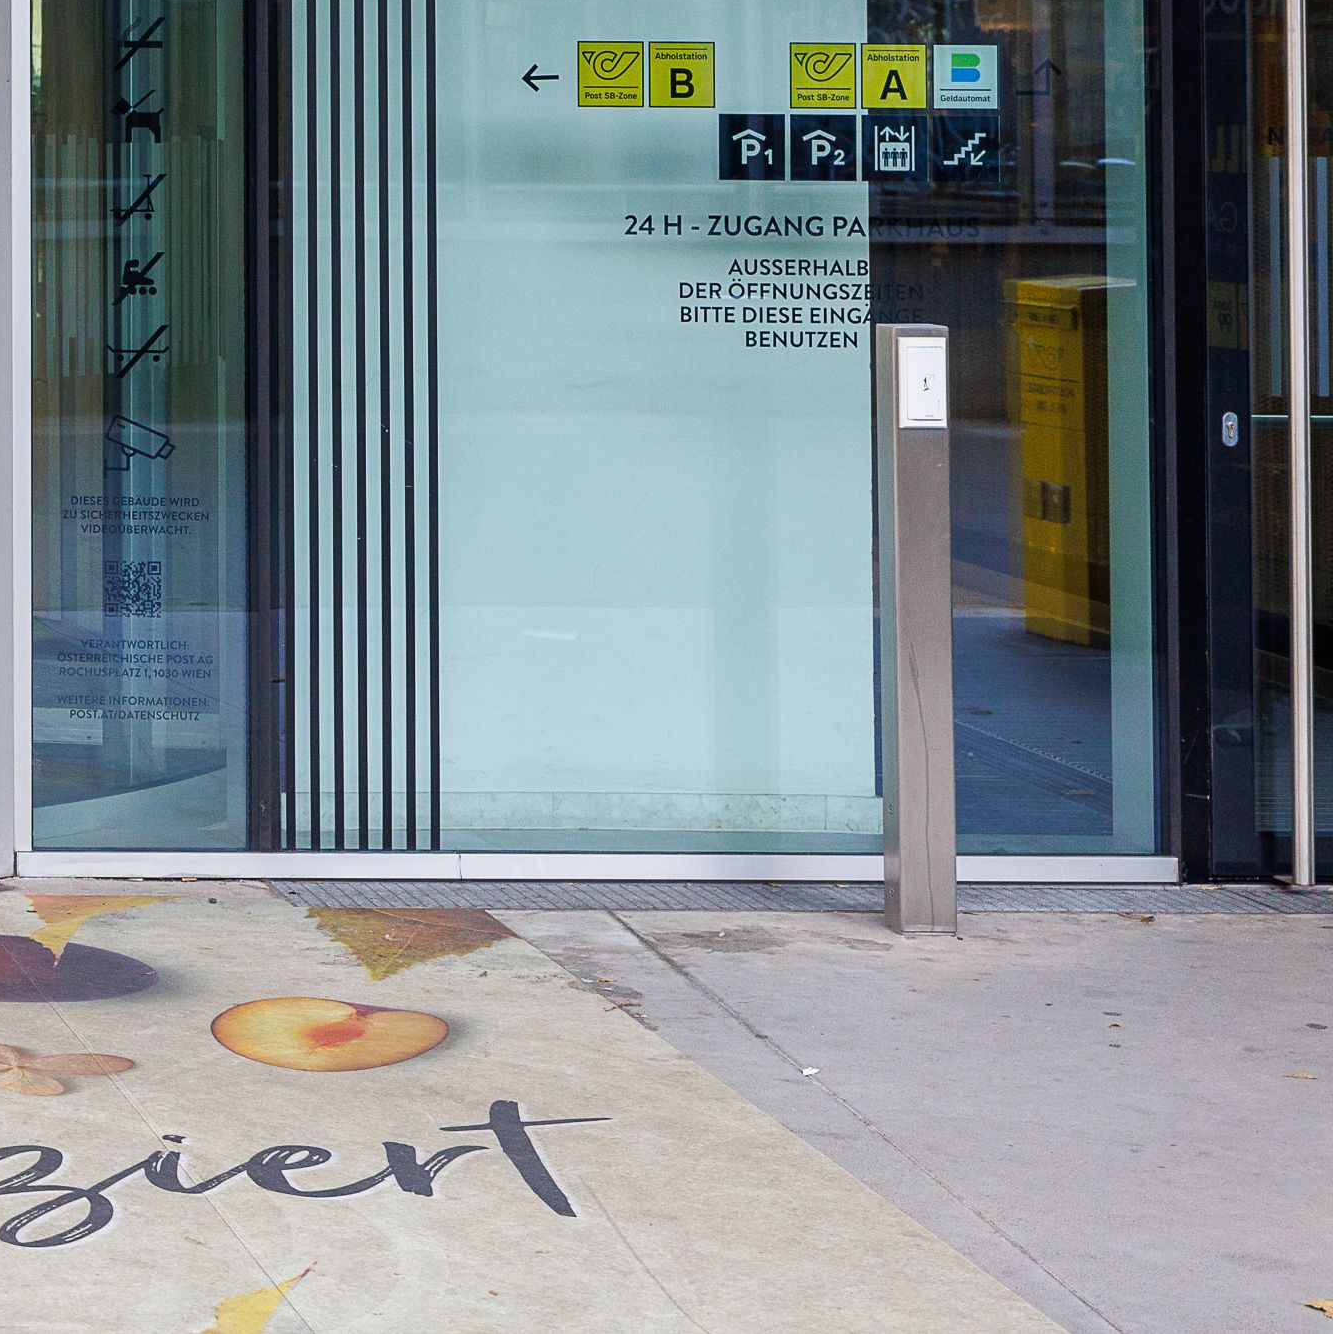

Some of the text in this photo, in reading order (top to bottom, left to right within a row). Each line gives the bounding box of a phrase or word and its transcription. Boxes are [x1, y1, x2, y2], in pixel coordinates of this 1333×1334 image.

[654, 51, 708, 62] Abholstation
[866, 53, 920, 63] Abholstation
[670, 68, 694, 99] B
[879, 69, 908, 100] A
[584, 91, 638, 101] Post SB-Zone
[796, 93, 850, 102] Post SB-Zone
[939, 94, 991, 103] Geldautomat
[624, 215, 655, 236] 24
[664, 215, 682, 236] H
[708, 215, 823, 237] ZUGANG
[728, 258, 869, 277] AUSSERHALB
[680, 278, 924, 300] DER ÖFFNUNGSZEITEN
[680, 306, 735, 324] BITTE
[742, 306, 804, 324] DIESE
[745, 331, 858, 348] BENUTZEN
[70, 494, 200, 507] DIESES GEBÄUDE WIRD
[62, 510, 210, 521] ZU SICHERHEITSZWECKEN
[81, 640, 190, 651] VERANTWORTLICH:
[57, 651, 214, 665] ÖSTERREICHISCHE POST AG
[59, 667, 141, 678] ROCHUSPLATZ
[154, 668, 179, 679] 1030
[181, 668, 211, 679] WIEN
[57, 695, 210, 707] WEITERE INFORMATIONEN:
[70, 709, 200, 721] POST.AT/DATENSCHUTZ
